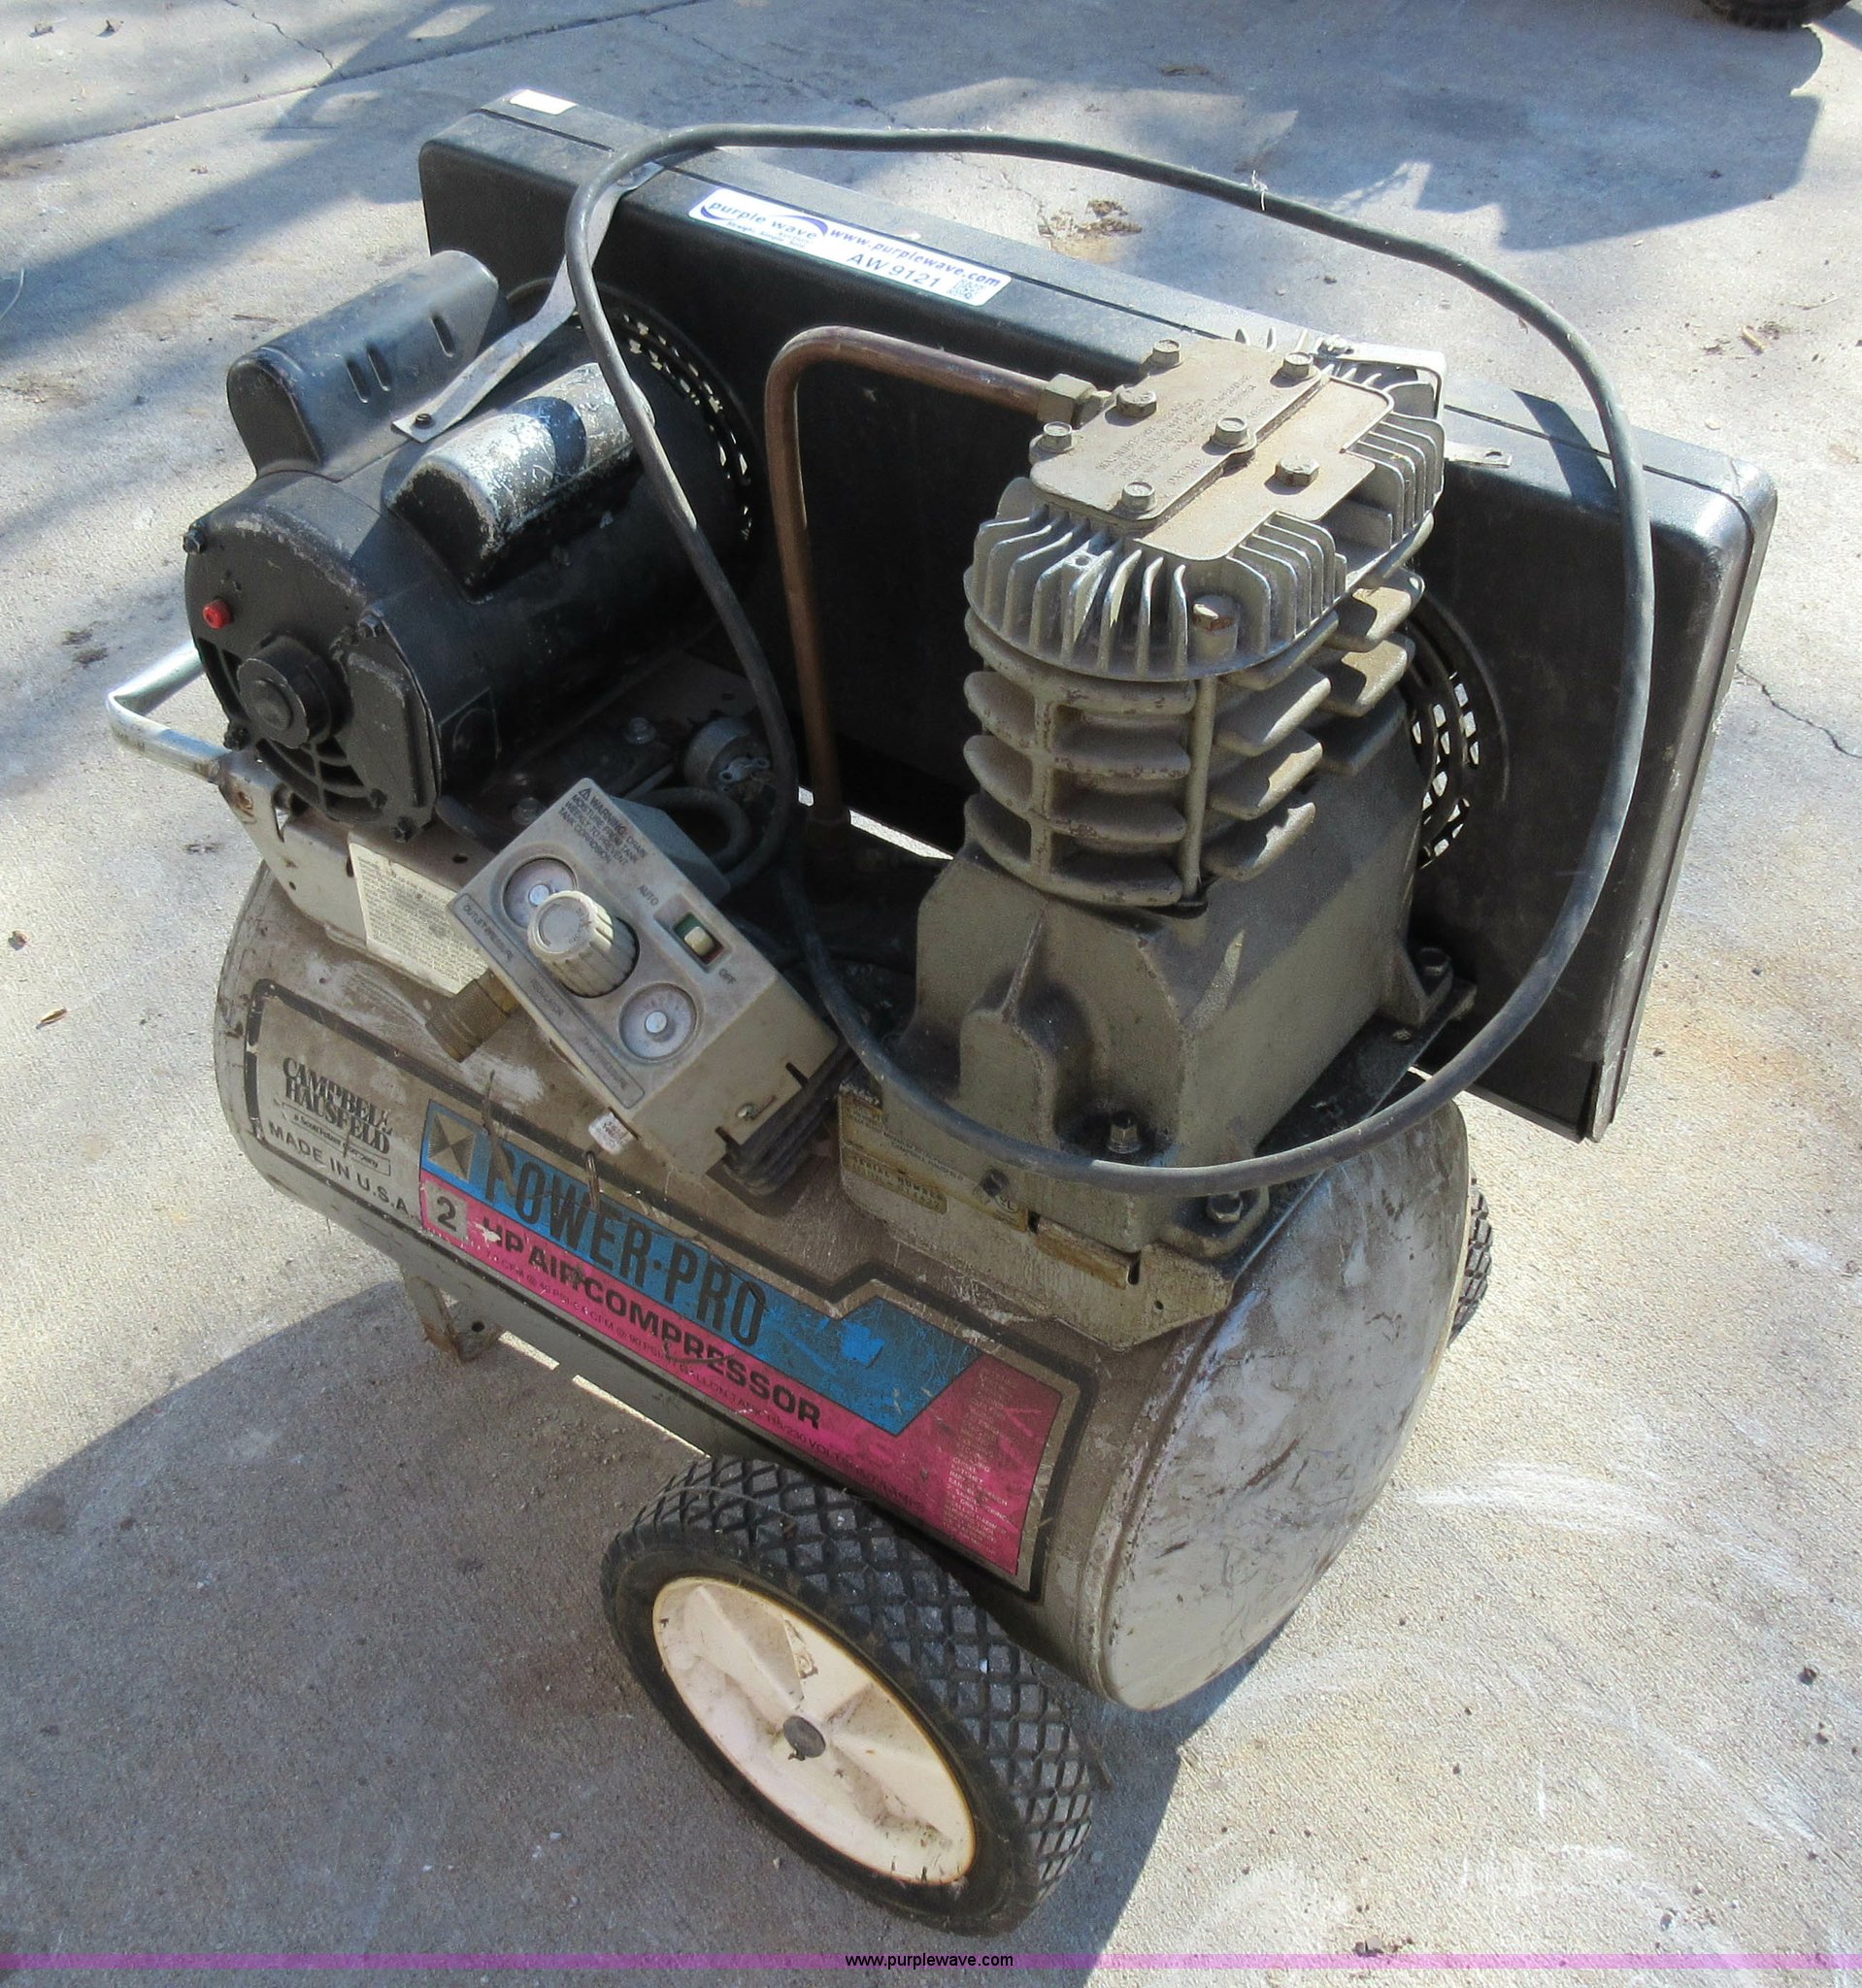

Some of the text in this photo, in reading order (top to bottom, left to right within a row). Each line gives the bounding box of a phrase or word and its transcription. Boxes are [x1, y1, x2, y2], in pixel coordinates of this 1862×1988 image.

[709, 201, 766, 225] purple
[771, 220, 817, 240] wave
[829, 228, 1001, 287] www.purplewave.com
[847, 253, 941, 287] AW 9121
[558, 807, 575, 826] TANK
[565, 801, 628, 865] WEEKLY TO PREVENT
[572, 794, 605, 829] MOISTURE
[621, 844, 638, 864] TANK
[637, 884, 659, 907] AUTO
[462, 904, 514, 962] OUTLET PRESSURE
[268, 1120, 325, 1167] MADE
[330, 1157, 350, 1181] IN
[436, 1196, 457, 1232] 2
